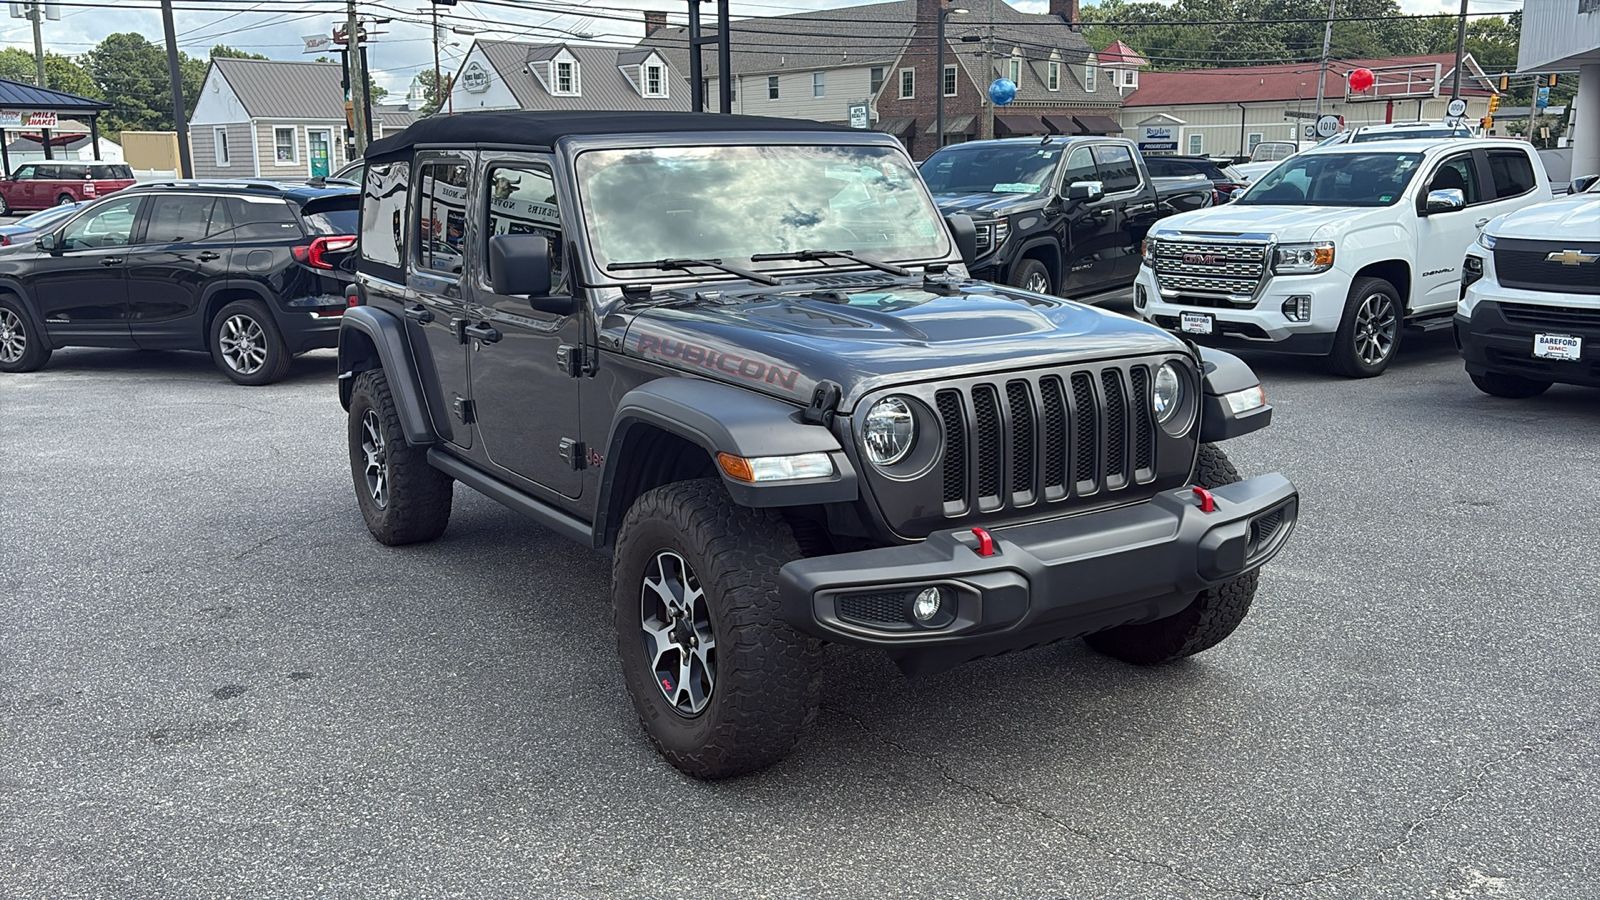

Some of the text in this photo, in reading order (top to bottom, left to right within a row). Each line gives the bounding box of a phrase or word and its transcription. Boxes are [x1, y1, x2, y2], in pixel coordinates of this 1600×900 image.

[32, 111, 56, 119] MILK
[1320, 121, 1337, 131] 1010
[1183, 253, 1226, 267] GMC
[1422, 267, 1455, 277] DENALI
[1184, 316, 1210, 324] BAREFORD
[1539, 337, 1578, 347] BAREFORD
[637, 332, 800, 391] RUBICON
